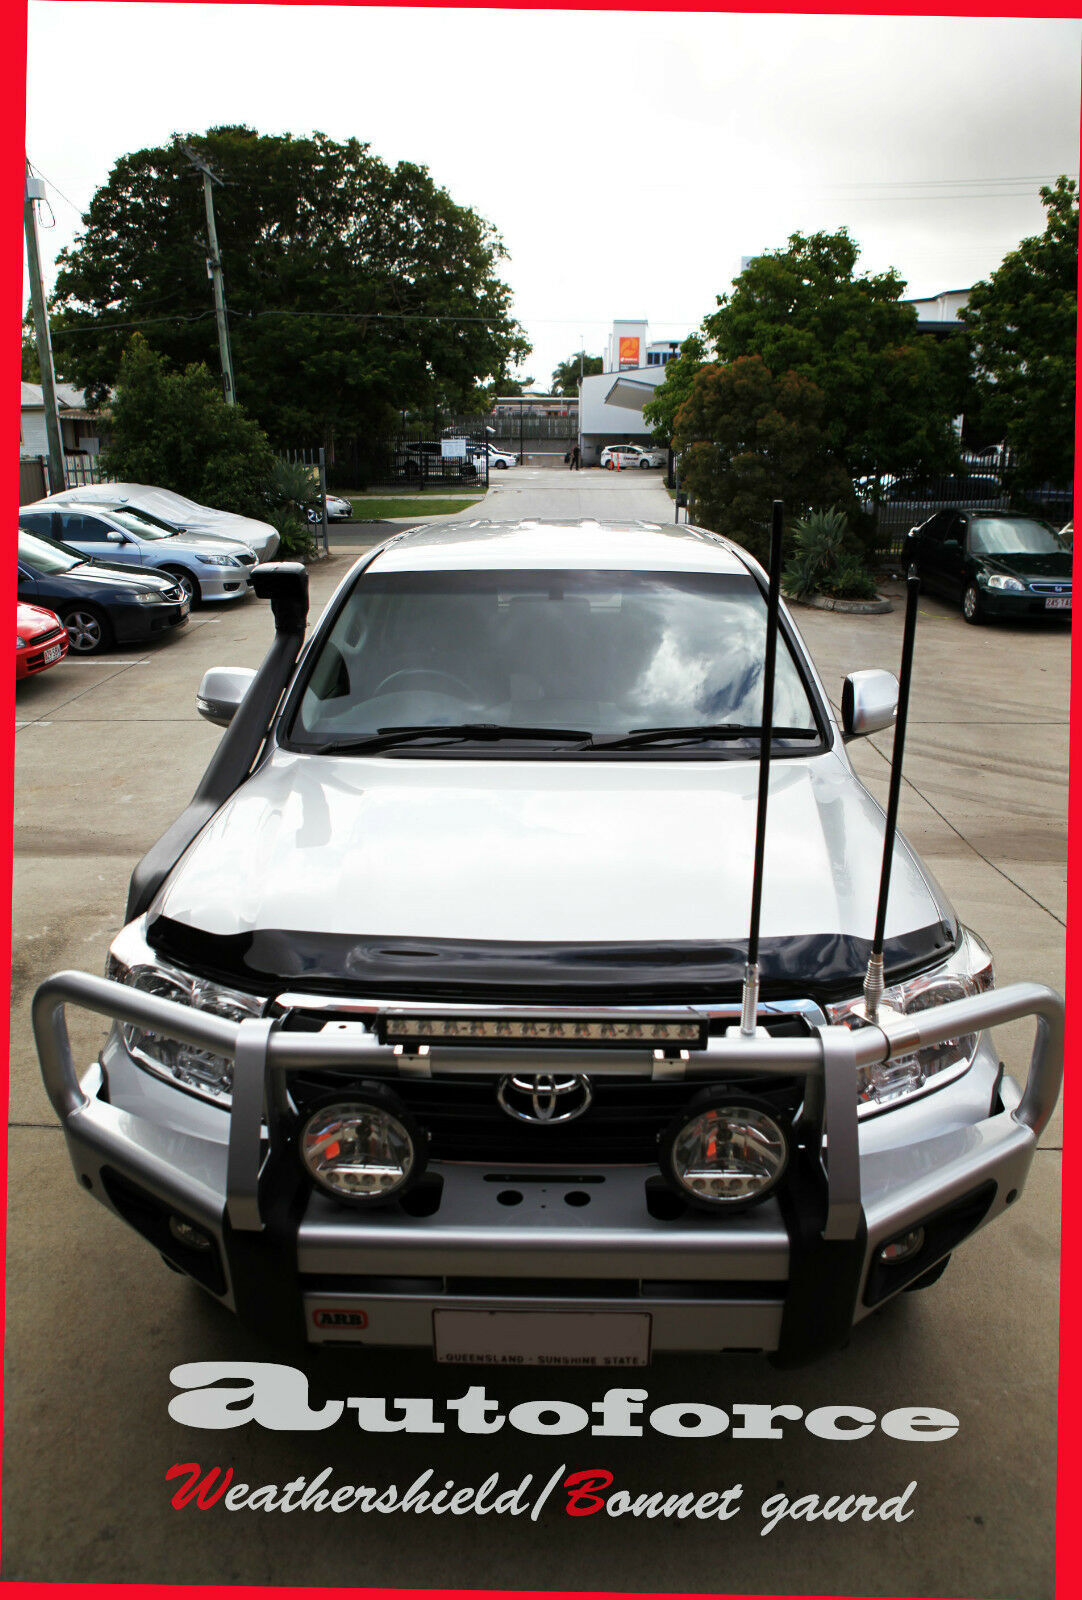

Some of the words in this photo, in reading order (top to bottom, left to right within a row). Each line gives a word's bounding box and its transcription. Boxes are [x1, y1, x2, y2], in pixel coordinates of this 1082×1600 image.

[320, 1312, 362, 1327] ARB
[445, 1352, 525, 1364] QUEENSLAND
[537, 1354, 597, 1365] SUNSHINE
[604, 1355, 639, 1366] STATE
